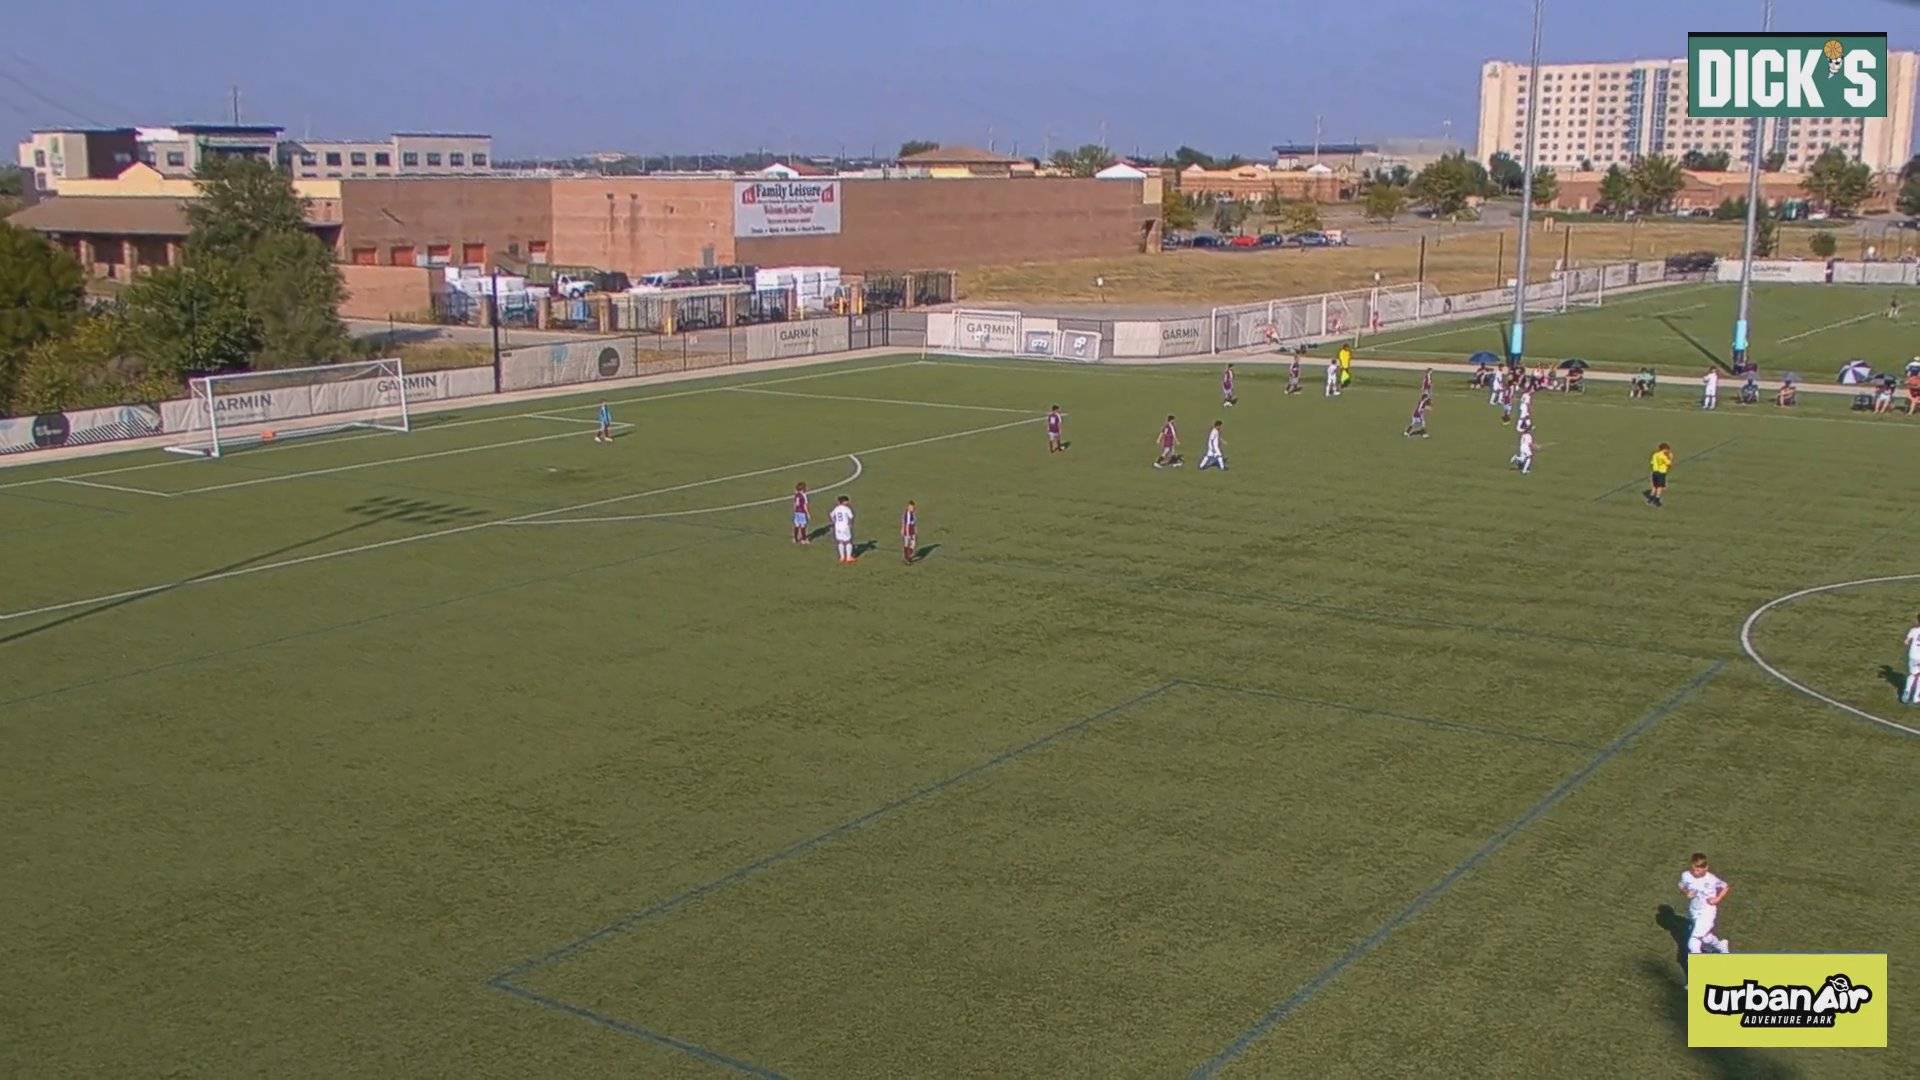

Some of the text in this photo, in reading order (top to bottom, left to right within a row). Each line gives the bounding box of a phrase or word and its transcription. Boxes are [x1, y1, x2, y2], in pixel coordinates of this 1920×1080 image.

[756, 183, 787, 199] Family
[789, 182, 821, 197] Leisure
[966, 322, 1016, 335] GARMIN
[1162, 327, 1199, 340] GARMIN
